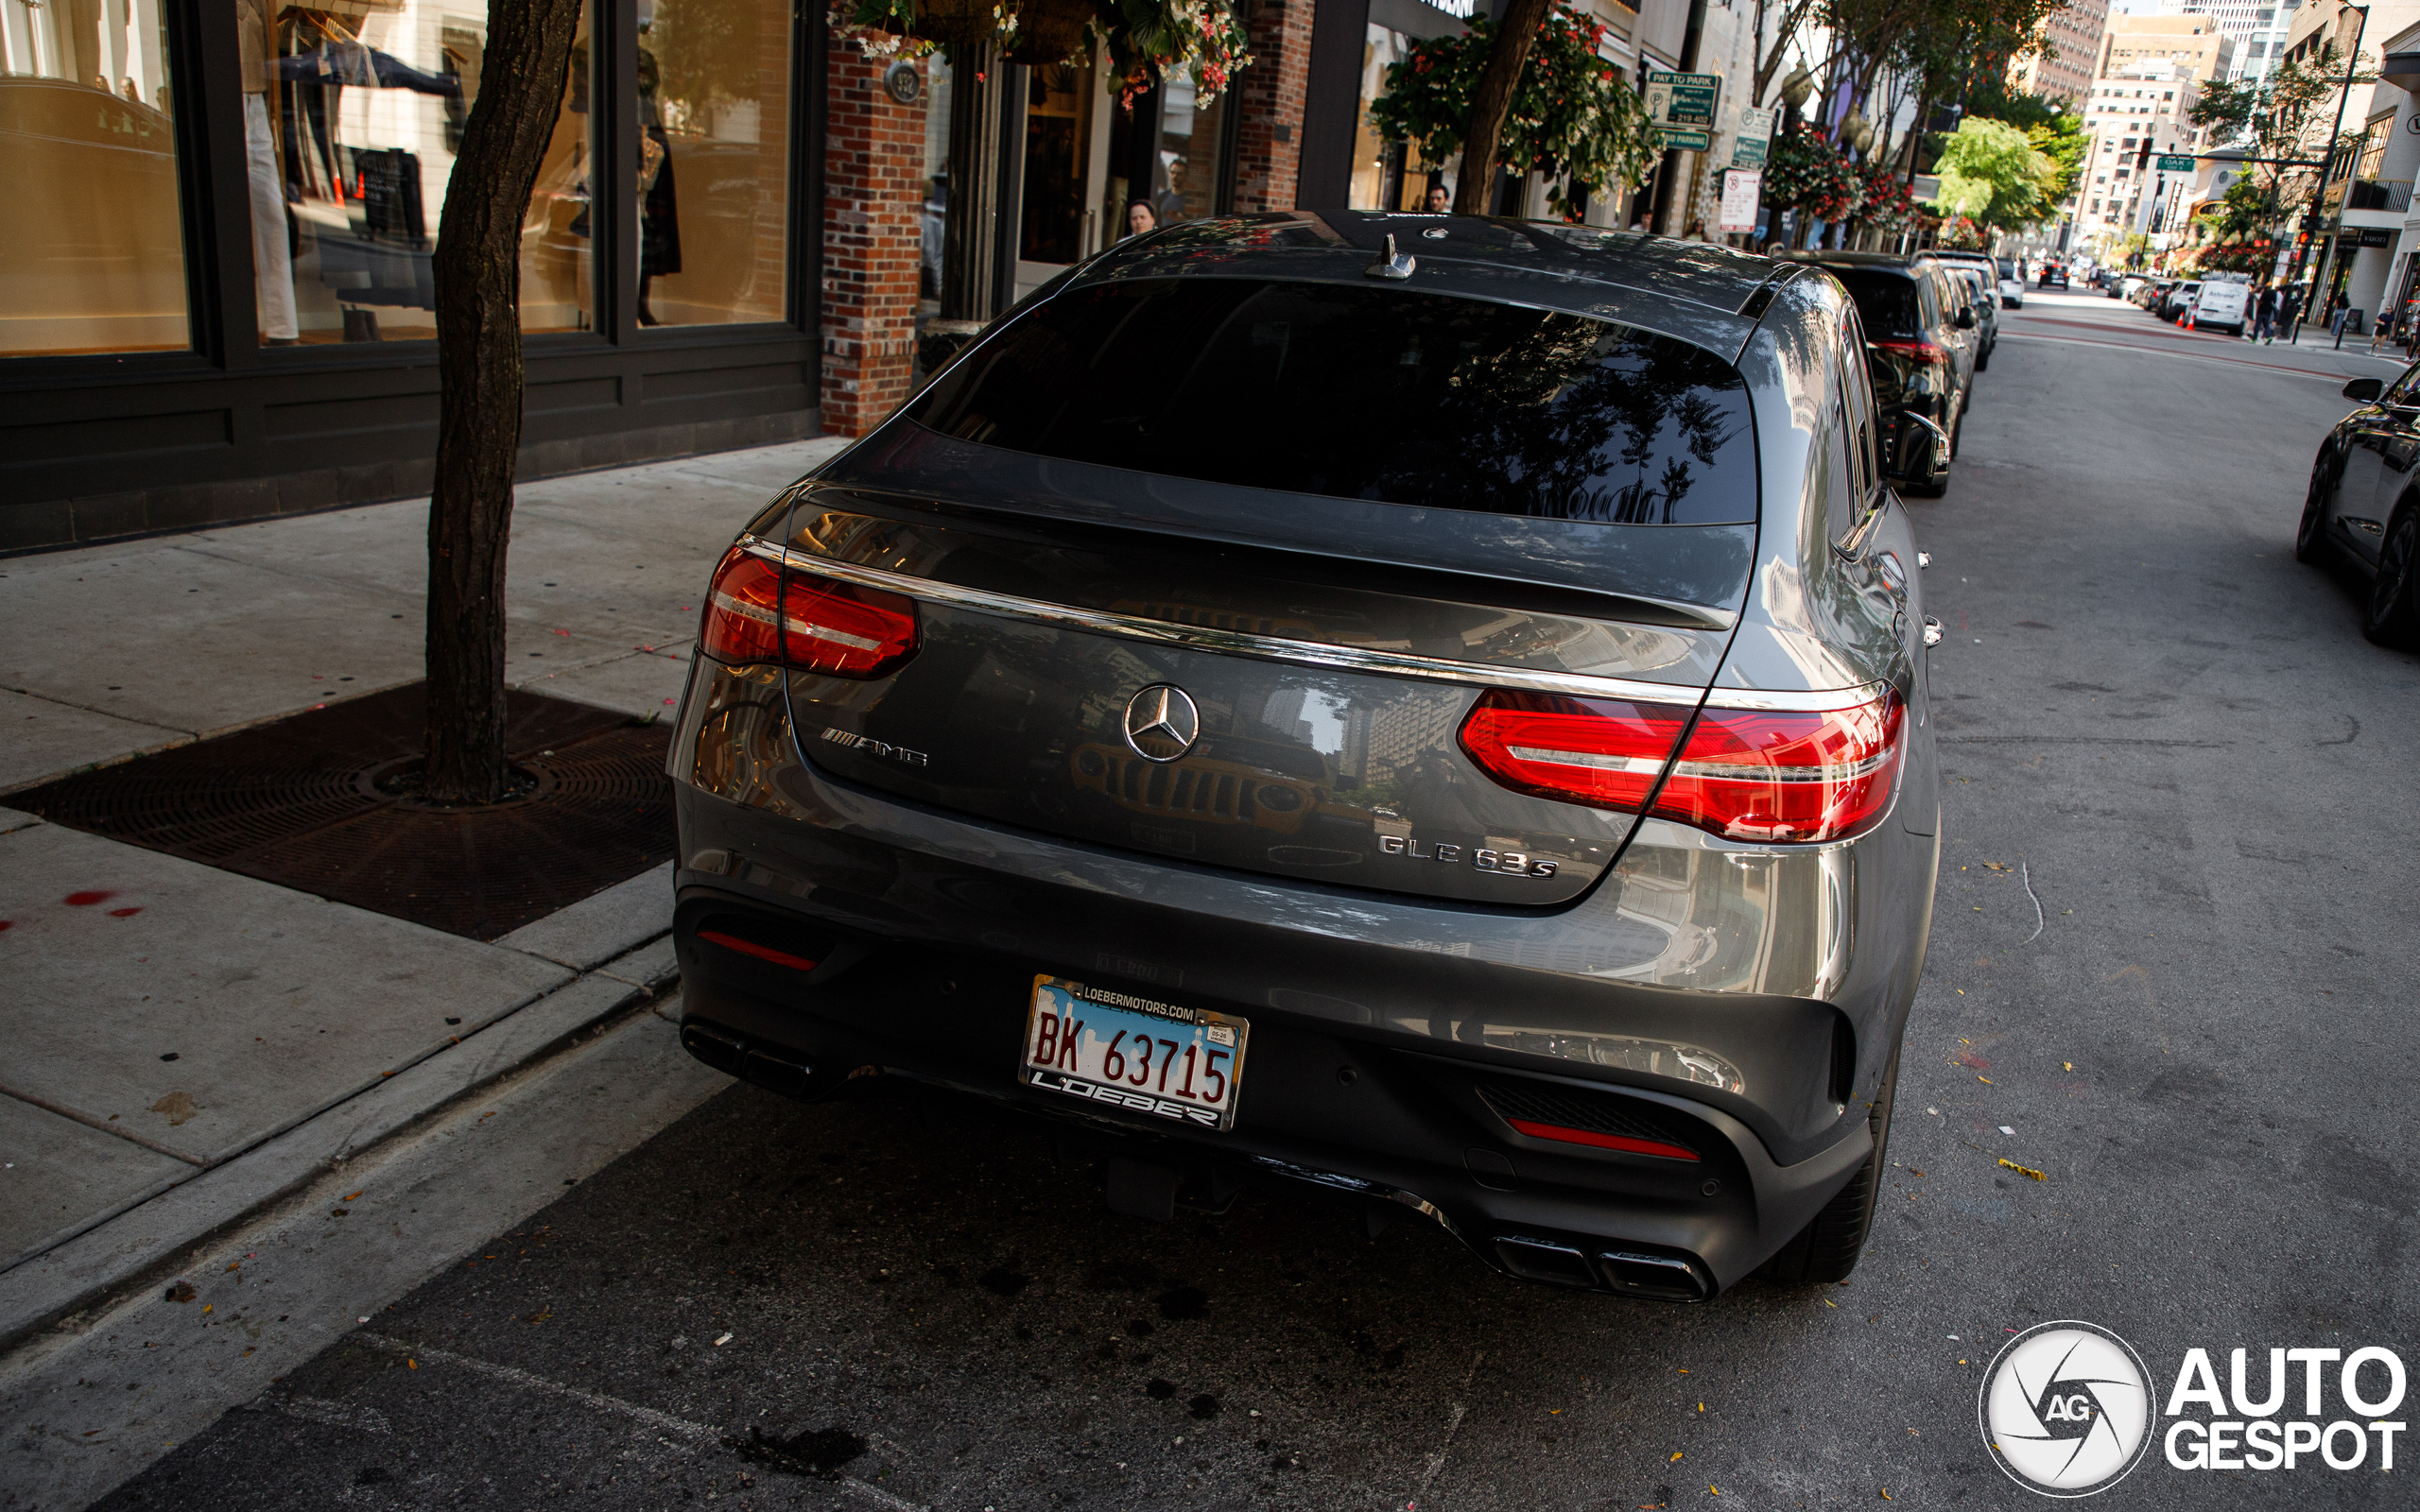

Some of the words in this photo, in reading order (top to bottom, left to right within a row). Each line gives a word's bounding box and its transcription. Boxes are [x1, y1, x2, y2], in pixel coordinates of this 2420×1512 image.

[1652, 73, 1671, 83] PAY
[1672, 75, 1685, 84] TO
[1686, 76, 1712, 86] PARK
[1676, 133, 1706, 146] PARKING
[853, 736, 928, 767] AMG
[1377, 834, 1462, 864] GLE
[1472, 848, 1529, 874] 63
[1083, 987, 1194, 1022] LOEBERMOTORS.COM
[1033, 1011, 1085, 1073] BK
[1103, 1030, 1230, 1104] 63715
[1030, 1071, 1219, 1127] LOEBER
